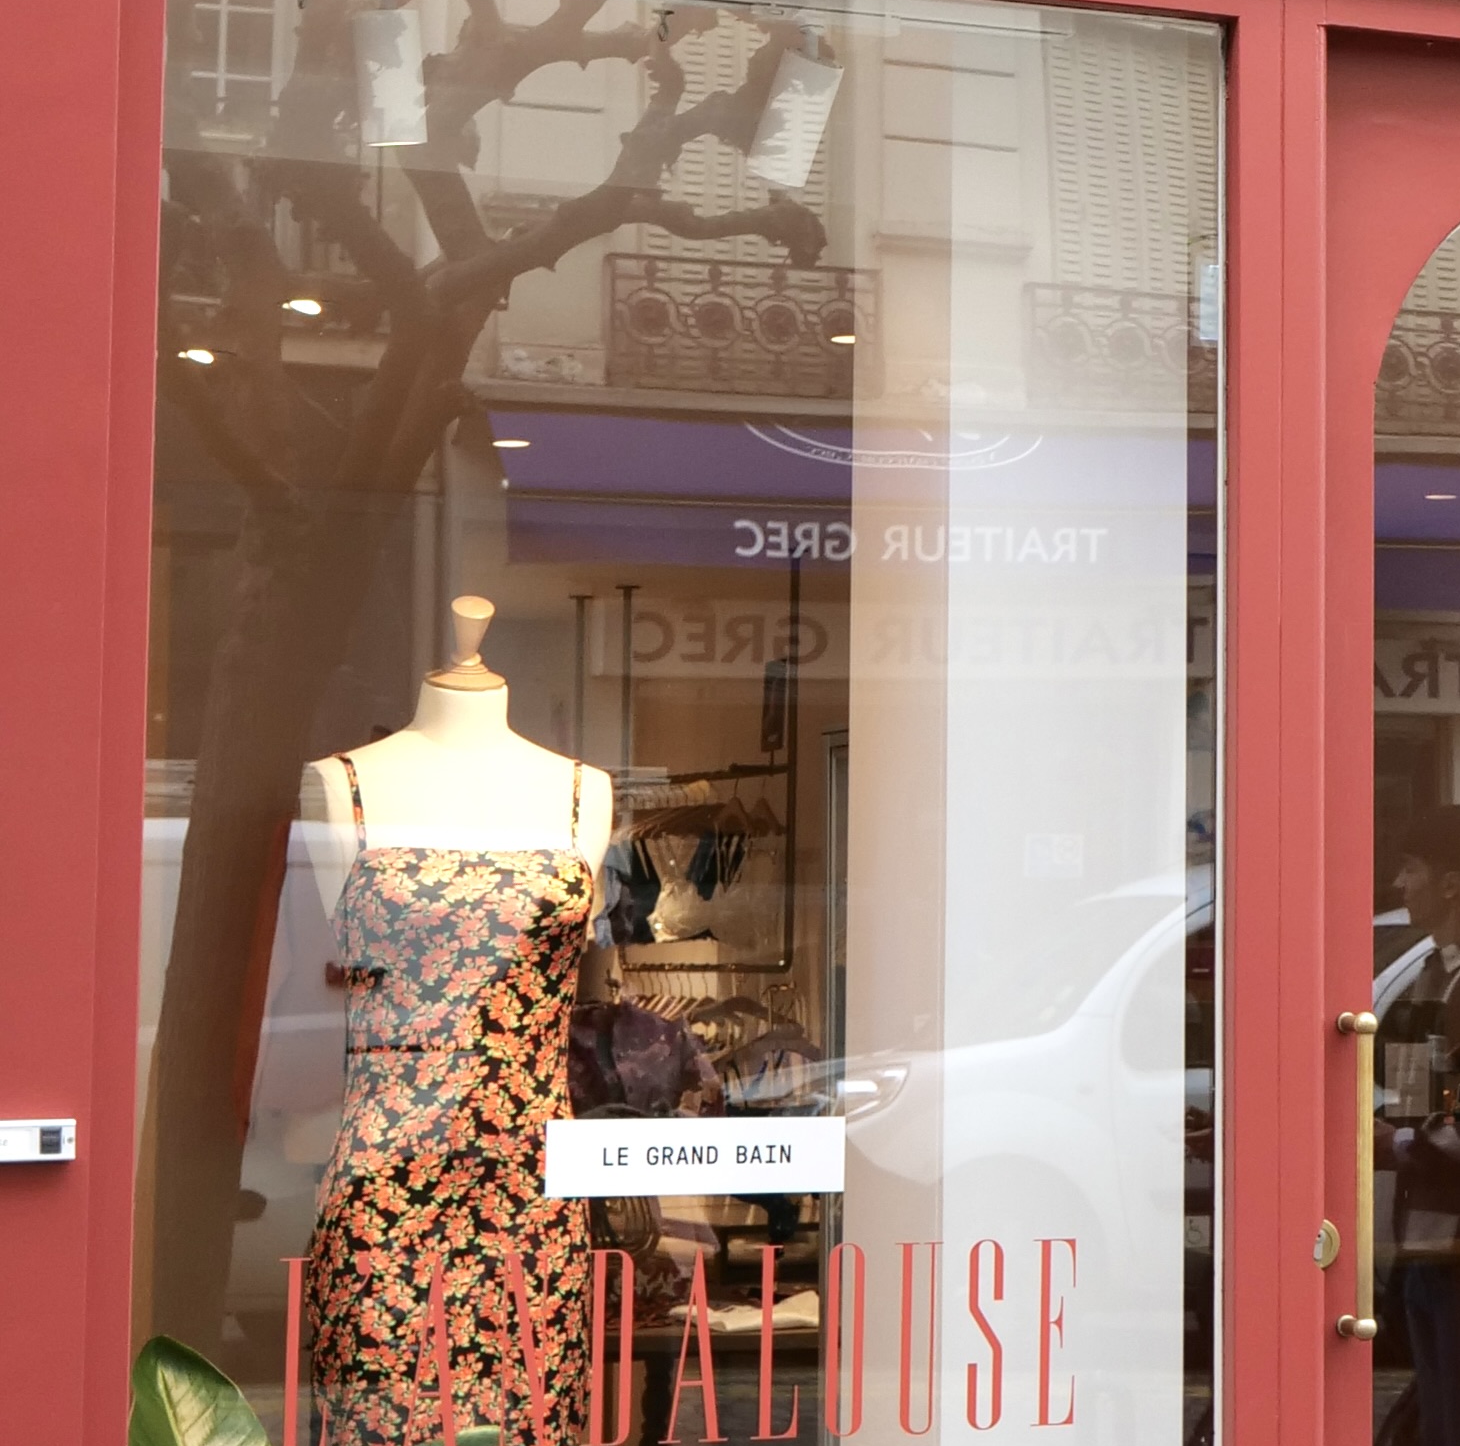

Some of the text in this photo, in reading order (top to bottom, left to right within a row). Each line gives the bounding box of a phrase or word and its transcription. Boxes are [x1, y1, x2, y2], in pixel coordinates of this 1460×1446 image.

[602, 1145, 792, 1166] LE GRAND BAIN
